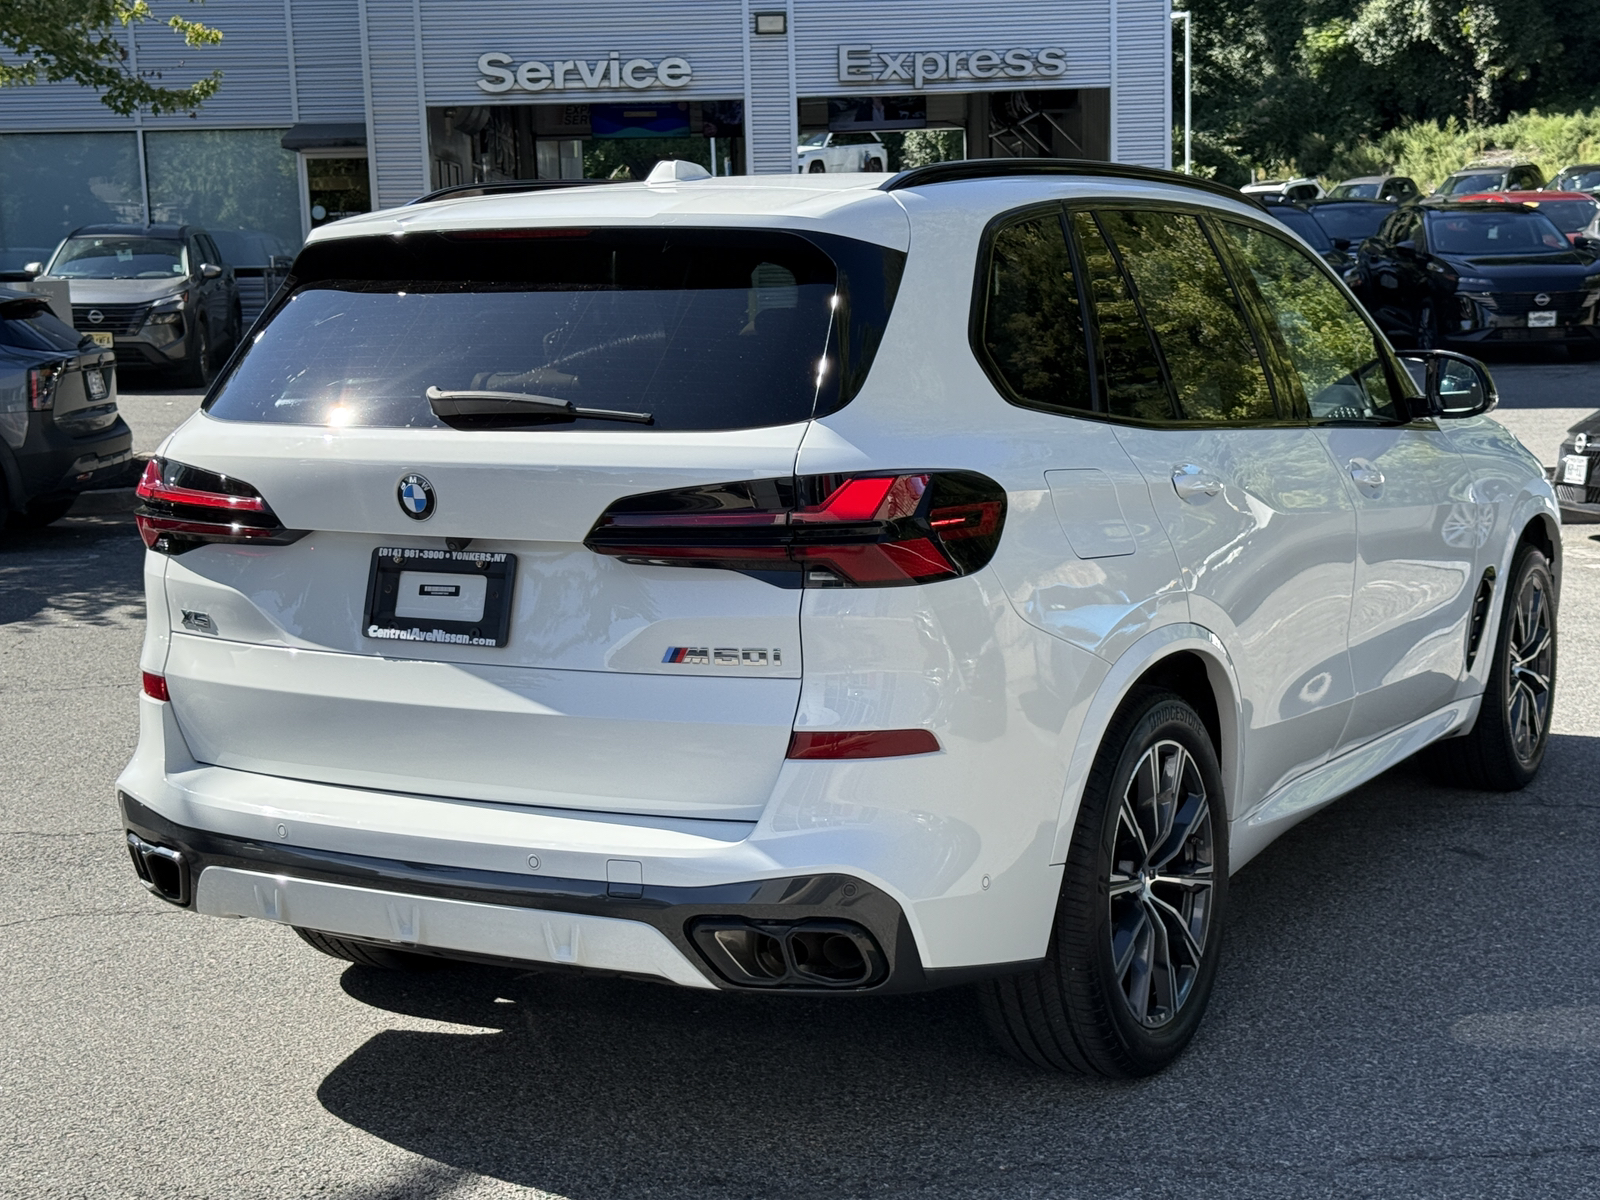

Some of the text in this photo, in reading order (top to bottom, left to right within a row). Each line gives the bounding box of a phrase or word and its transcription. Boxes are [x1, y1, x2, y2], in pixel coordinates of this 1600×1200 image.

[476, 51, 692, 93] Service
[838, 44, 1067, 89] Express
[564, 115, 590, 125] SER
[565, 105, 591, 115] EXP
[400, 476, 431, 491] BMW
[368, 624, 496, 647] CentralAveNissan.com
[681, 647, 782, 666] M60i
[1147, 705, 1203, 736] BRIDGESTONE
